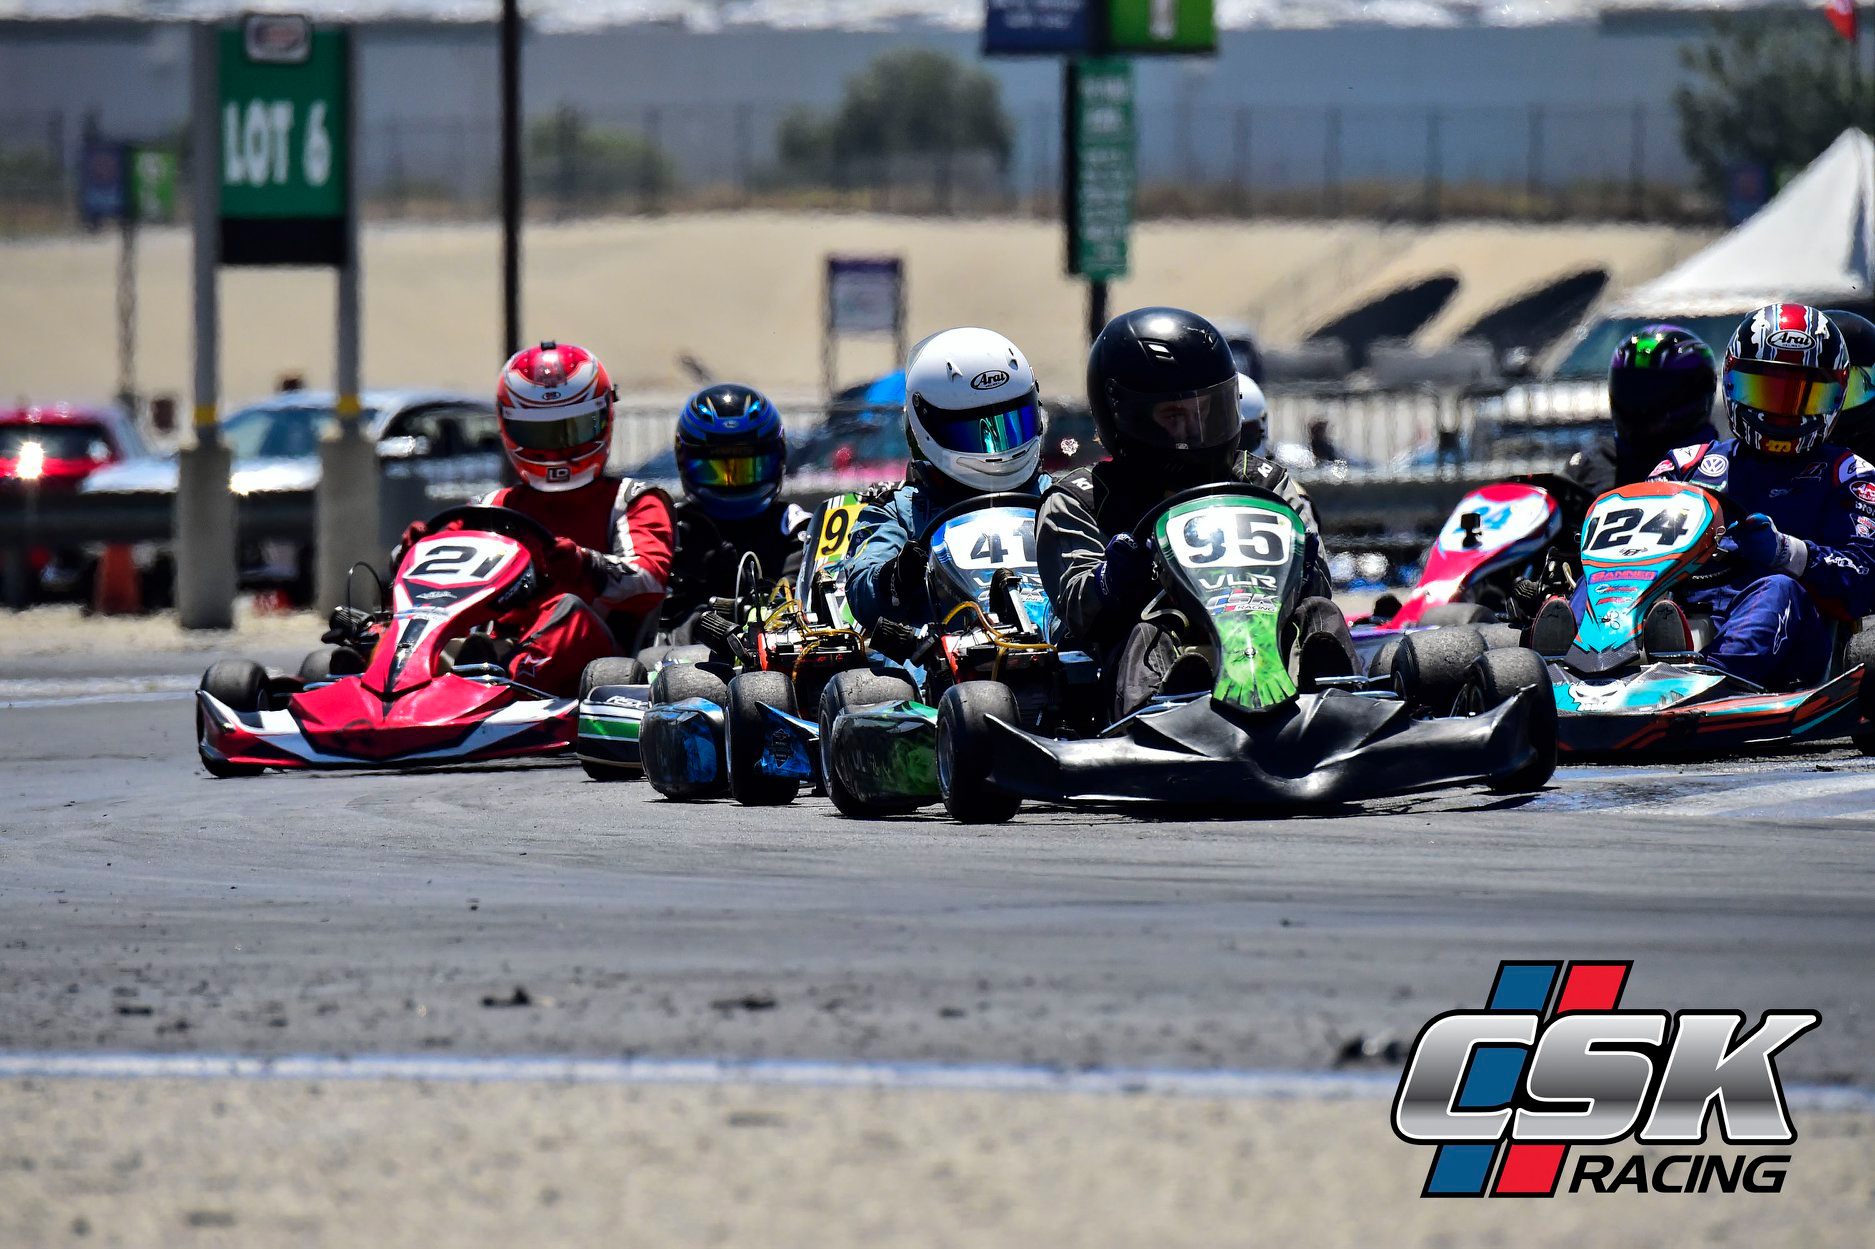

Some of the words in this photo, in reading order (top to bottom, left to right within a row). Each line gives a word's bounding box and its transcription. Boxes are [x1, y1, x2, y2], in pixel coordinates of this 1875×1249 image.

[223, 101, 293, 186] LOT
[303, 103, 332, 187] 6
[974, 371, 1007, 388] Arai
[821, 509, 849, 556] 9
[970, 519, 1038, 564] 41
[1183, 513, 1286, 565] 95
[1582, 507, 1689, 551] 124
[409, 545, 505, 579] 21
